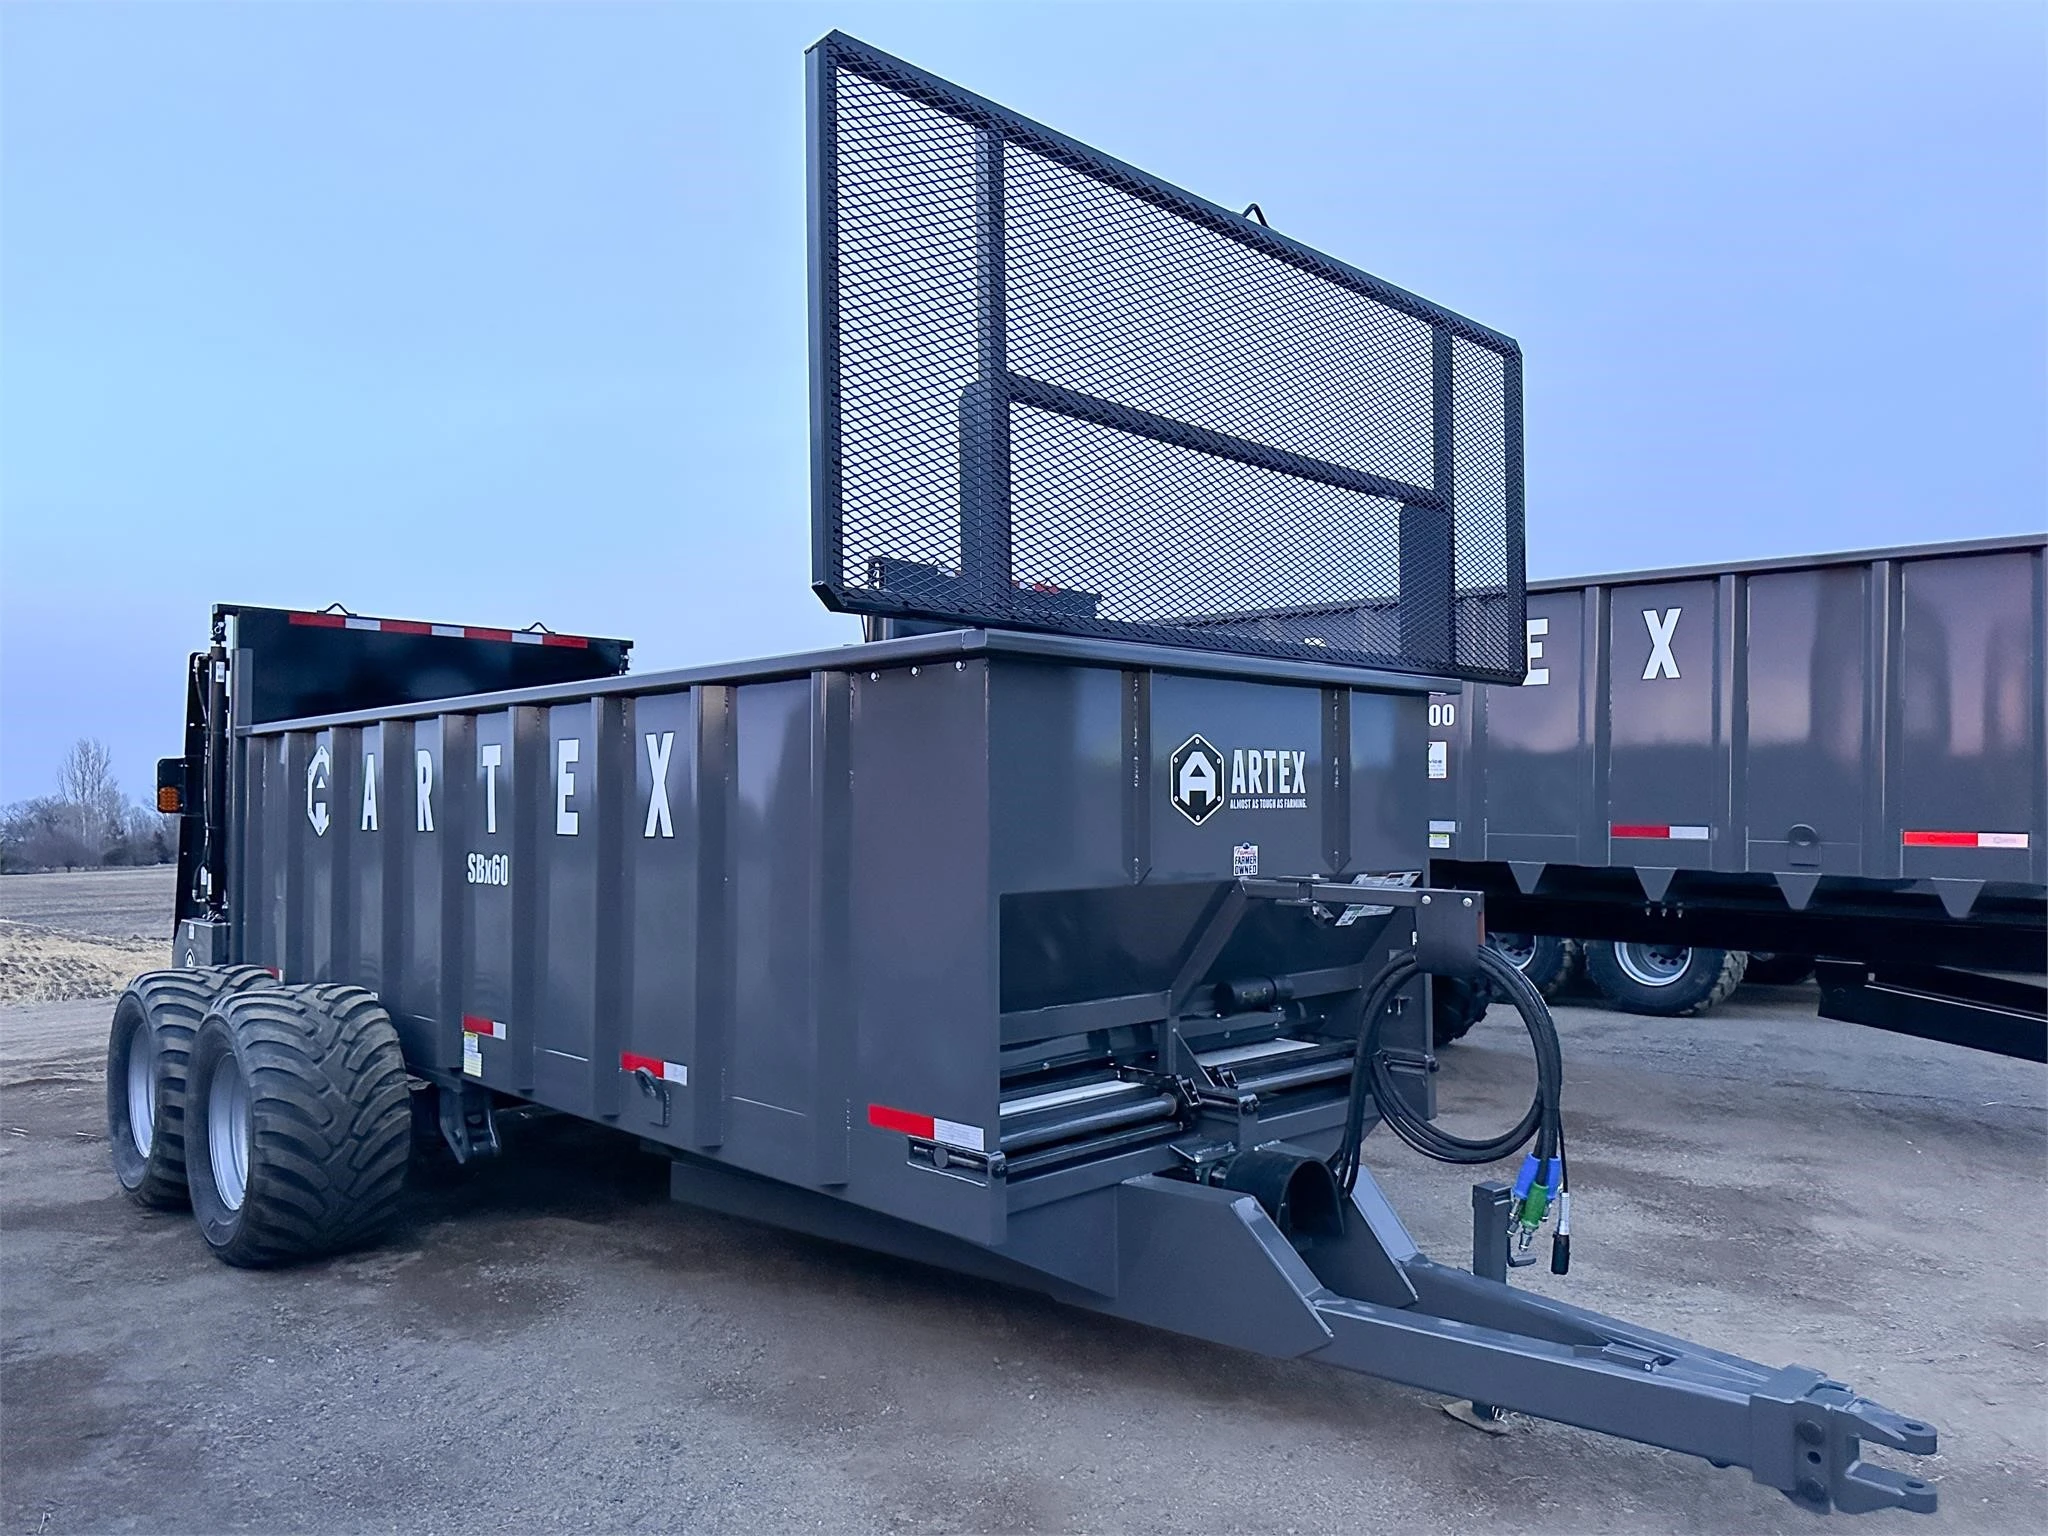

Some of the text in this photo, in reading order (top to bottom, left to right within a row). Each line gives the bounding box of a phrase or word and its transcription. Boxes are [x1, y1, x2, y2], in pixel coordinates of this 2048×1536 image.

[1231, 749, 1306, 794] ARTEX
[1229, 798, 1252, 809] ALMOST
[1252, 798, 1260, 809] AS
[1277, 798, 1284, 809] AS
[1235, 855, 1257, 865] FARMER
[467, 852, 509, 886] SBx60
[1235, 865, 1257, 875] OWNED
